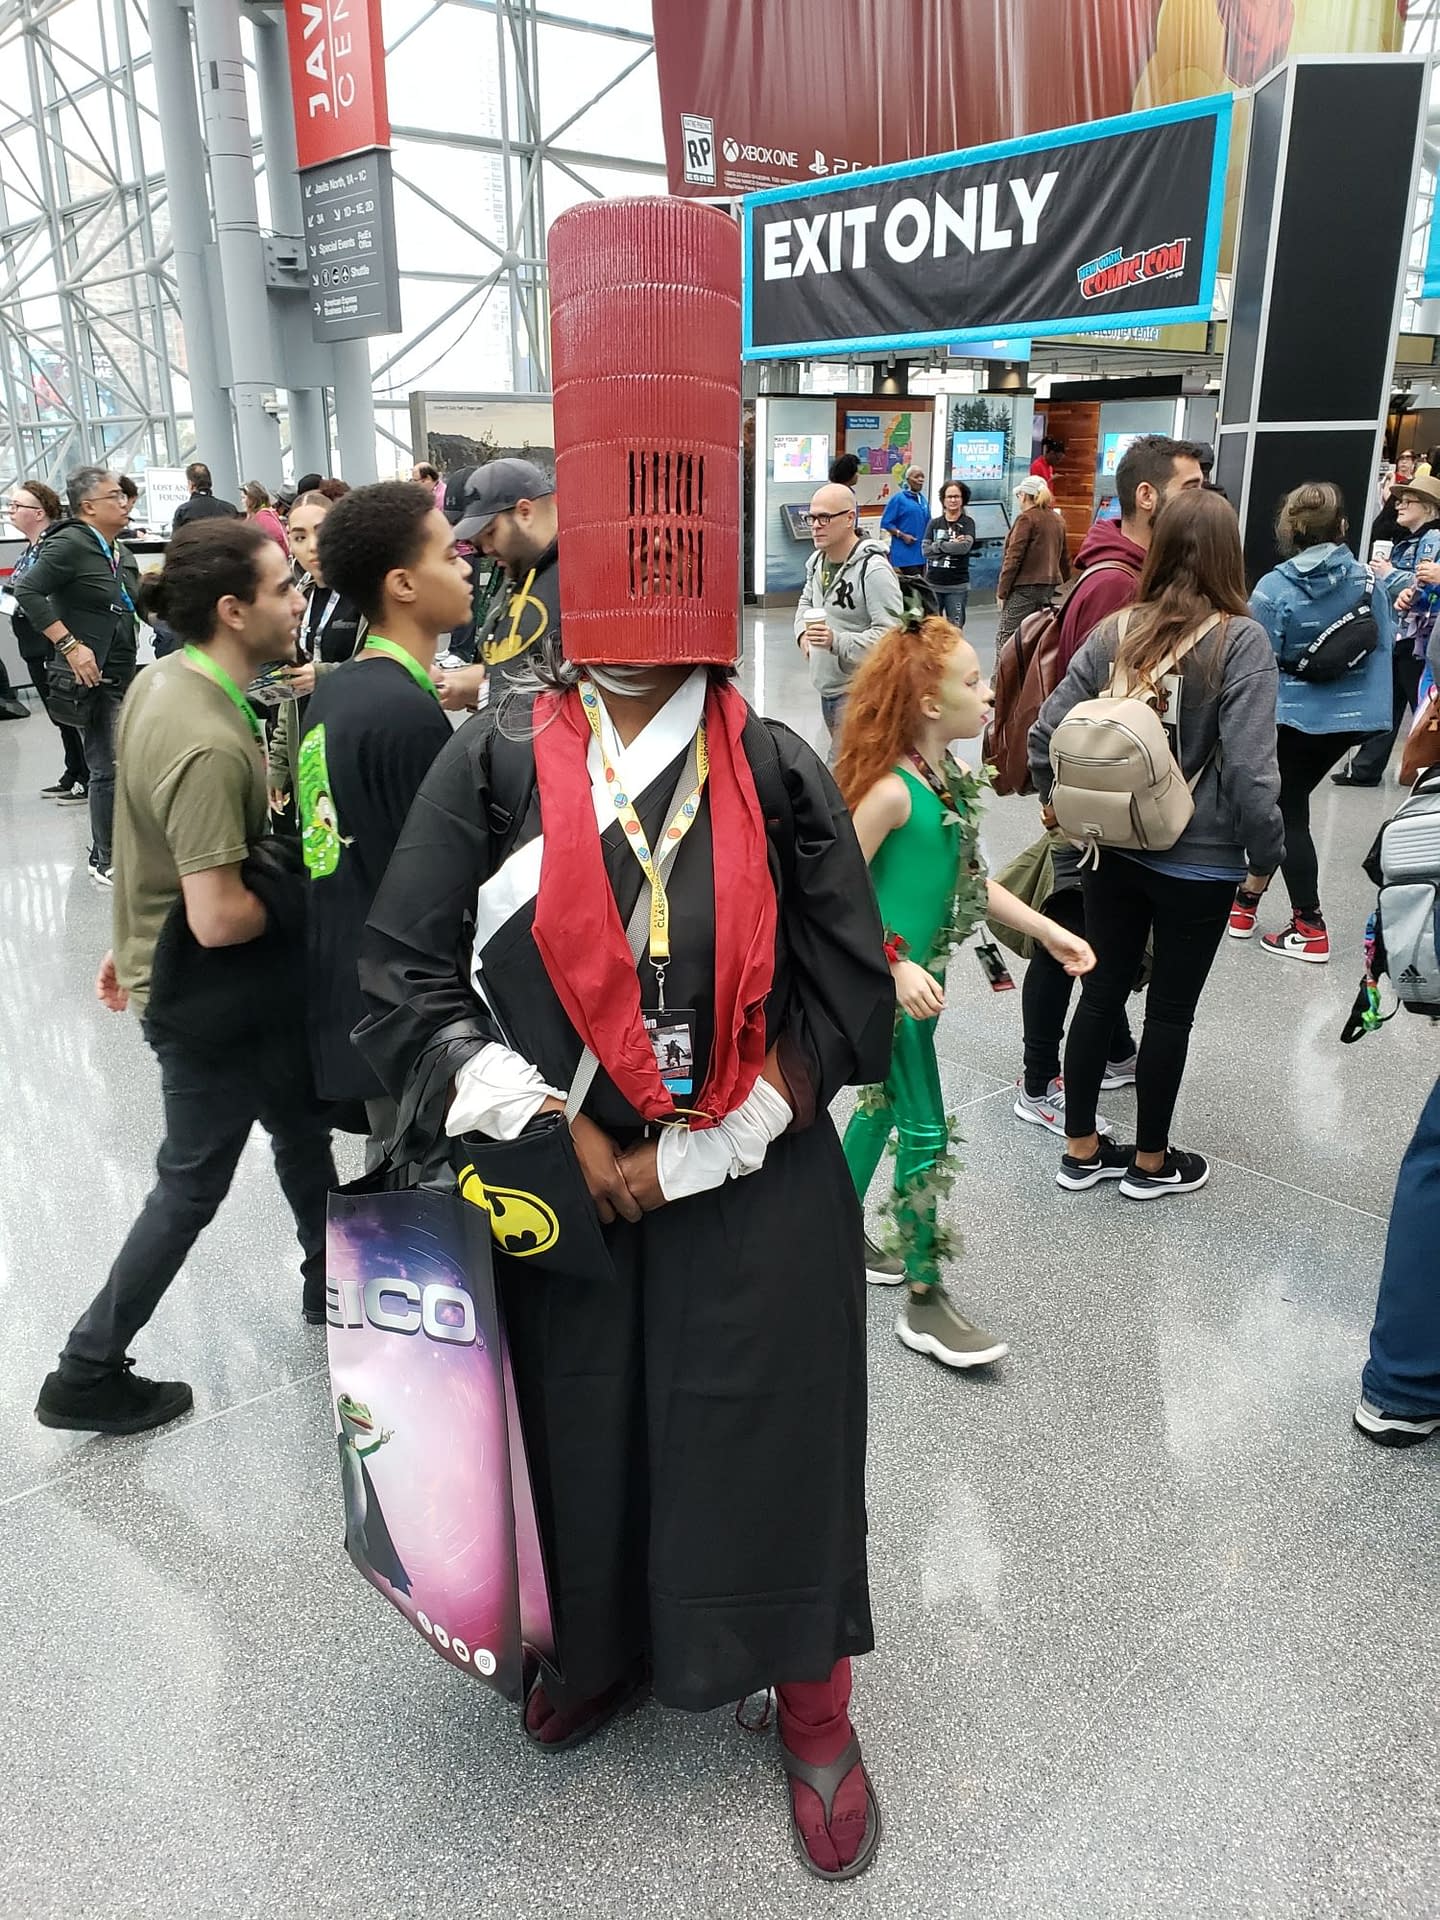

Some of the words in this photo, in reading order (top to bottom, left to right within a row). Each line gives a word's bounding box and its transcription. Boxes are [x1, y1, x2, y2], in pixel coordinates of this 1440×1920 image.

[301, 3, 330, 118] JAV
[688, 137, 711, 168] RP
[740, 144, 773, 164] XBOX
[773, 149, 799, 168] ONE
[763, 205, 877, 281] EXIT
[883, 171, 1060, 263] ONLY
[1079, 260, 1098, 280] NEW
[1098, 249, 1122, 270] YORK
[1083, 255, 1142, 297] COMIC
[1143, 241, 1184, 278] CON
[957, 444, 999, 454] TRAVELER
[175, 484, 189, 492] AN
[1308, 612, 1355, 654] SUPREME
